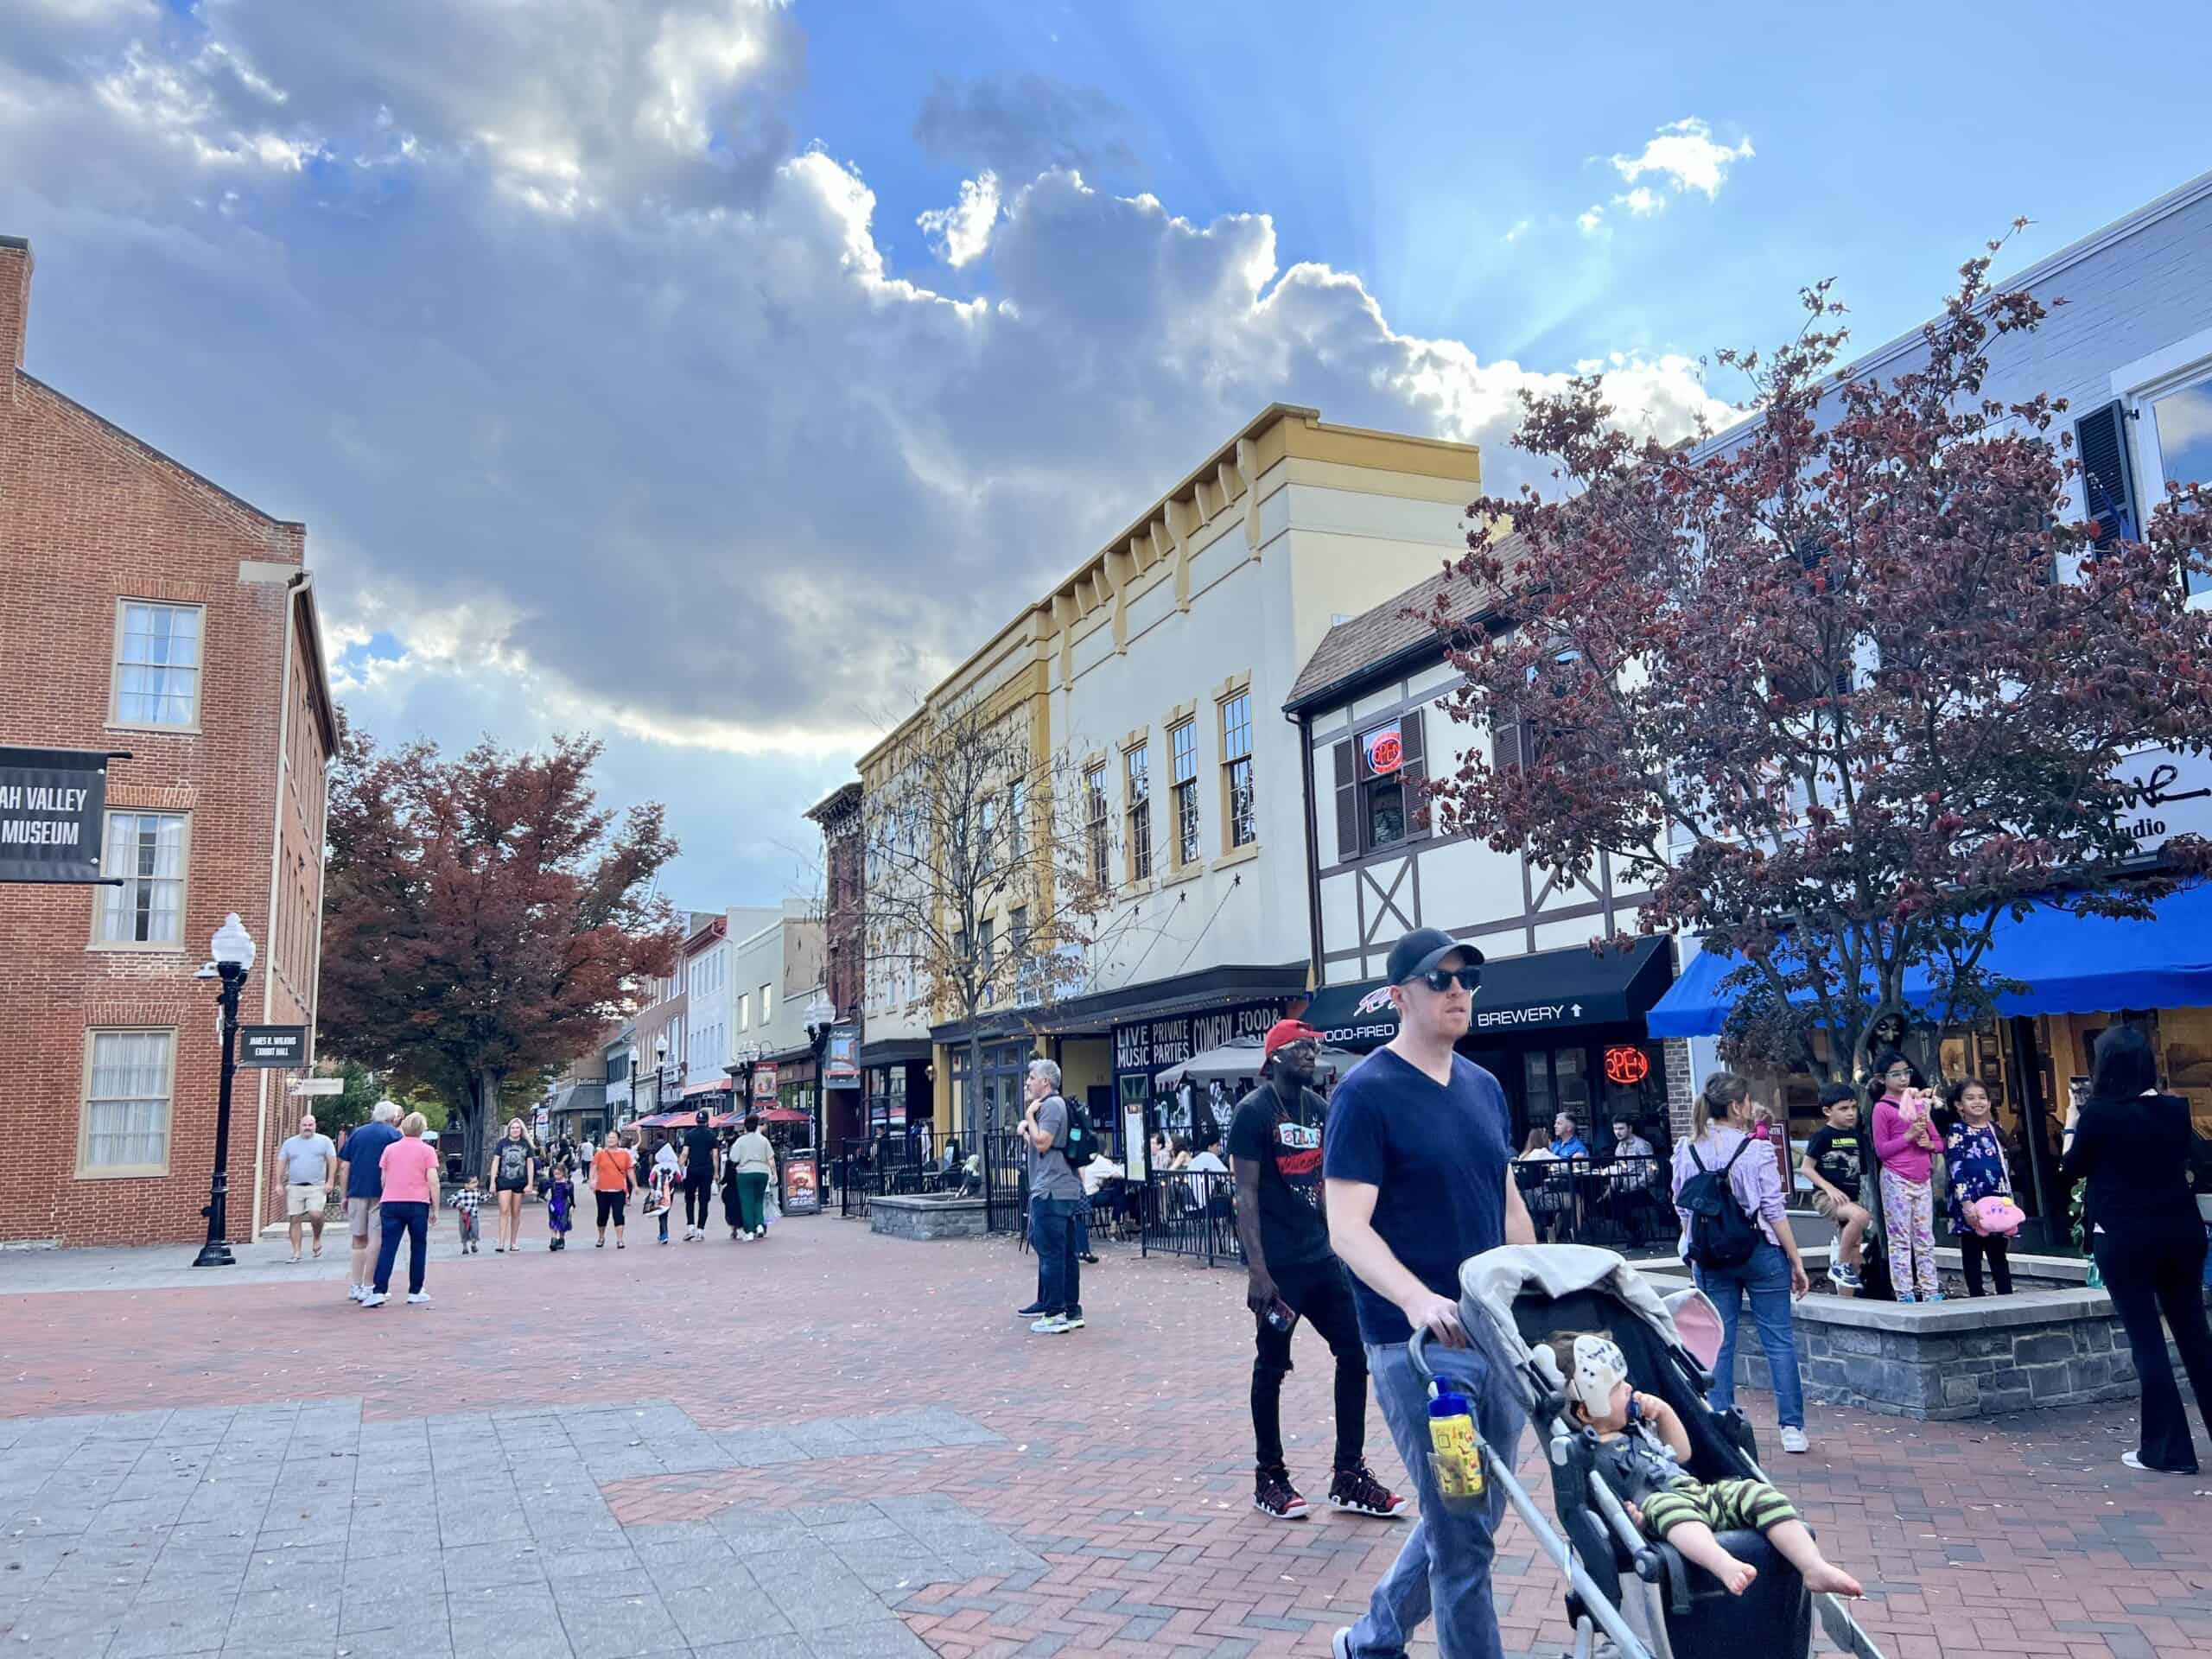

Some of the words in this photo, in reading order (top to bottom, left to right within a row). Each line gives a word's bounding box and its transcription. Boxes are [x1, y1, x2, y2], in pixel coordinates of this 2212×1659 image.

[1374, 741, 1399, 763] OPEN
[27, 787, 87, 811] VALLEY
[2, 820, 79, 845] MUSEUM
[1478, 1005, 1565, 1027] BREWERY
[1117, 1026, 1149, 1048] LIVE
[1153, 1020, 1189, 1044] PRIVATE
[1193, 1015, 1232, 1052] COMEDY
[1238, 1009, 1272, 1033] FOOD
[1317, 1024, 1395, 1043] OOD-FIRED
[1117, 1045, 1150, 1068] MUSIC
[1154, 1041, 1190, 1065] PARTIES
[1605, 1051, 1646, 1079] OPEN
